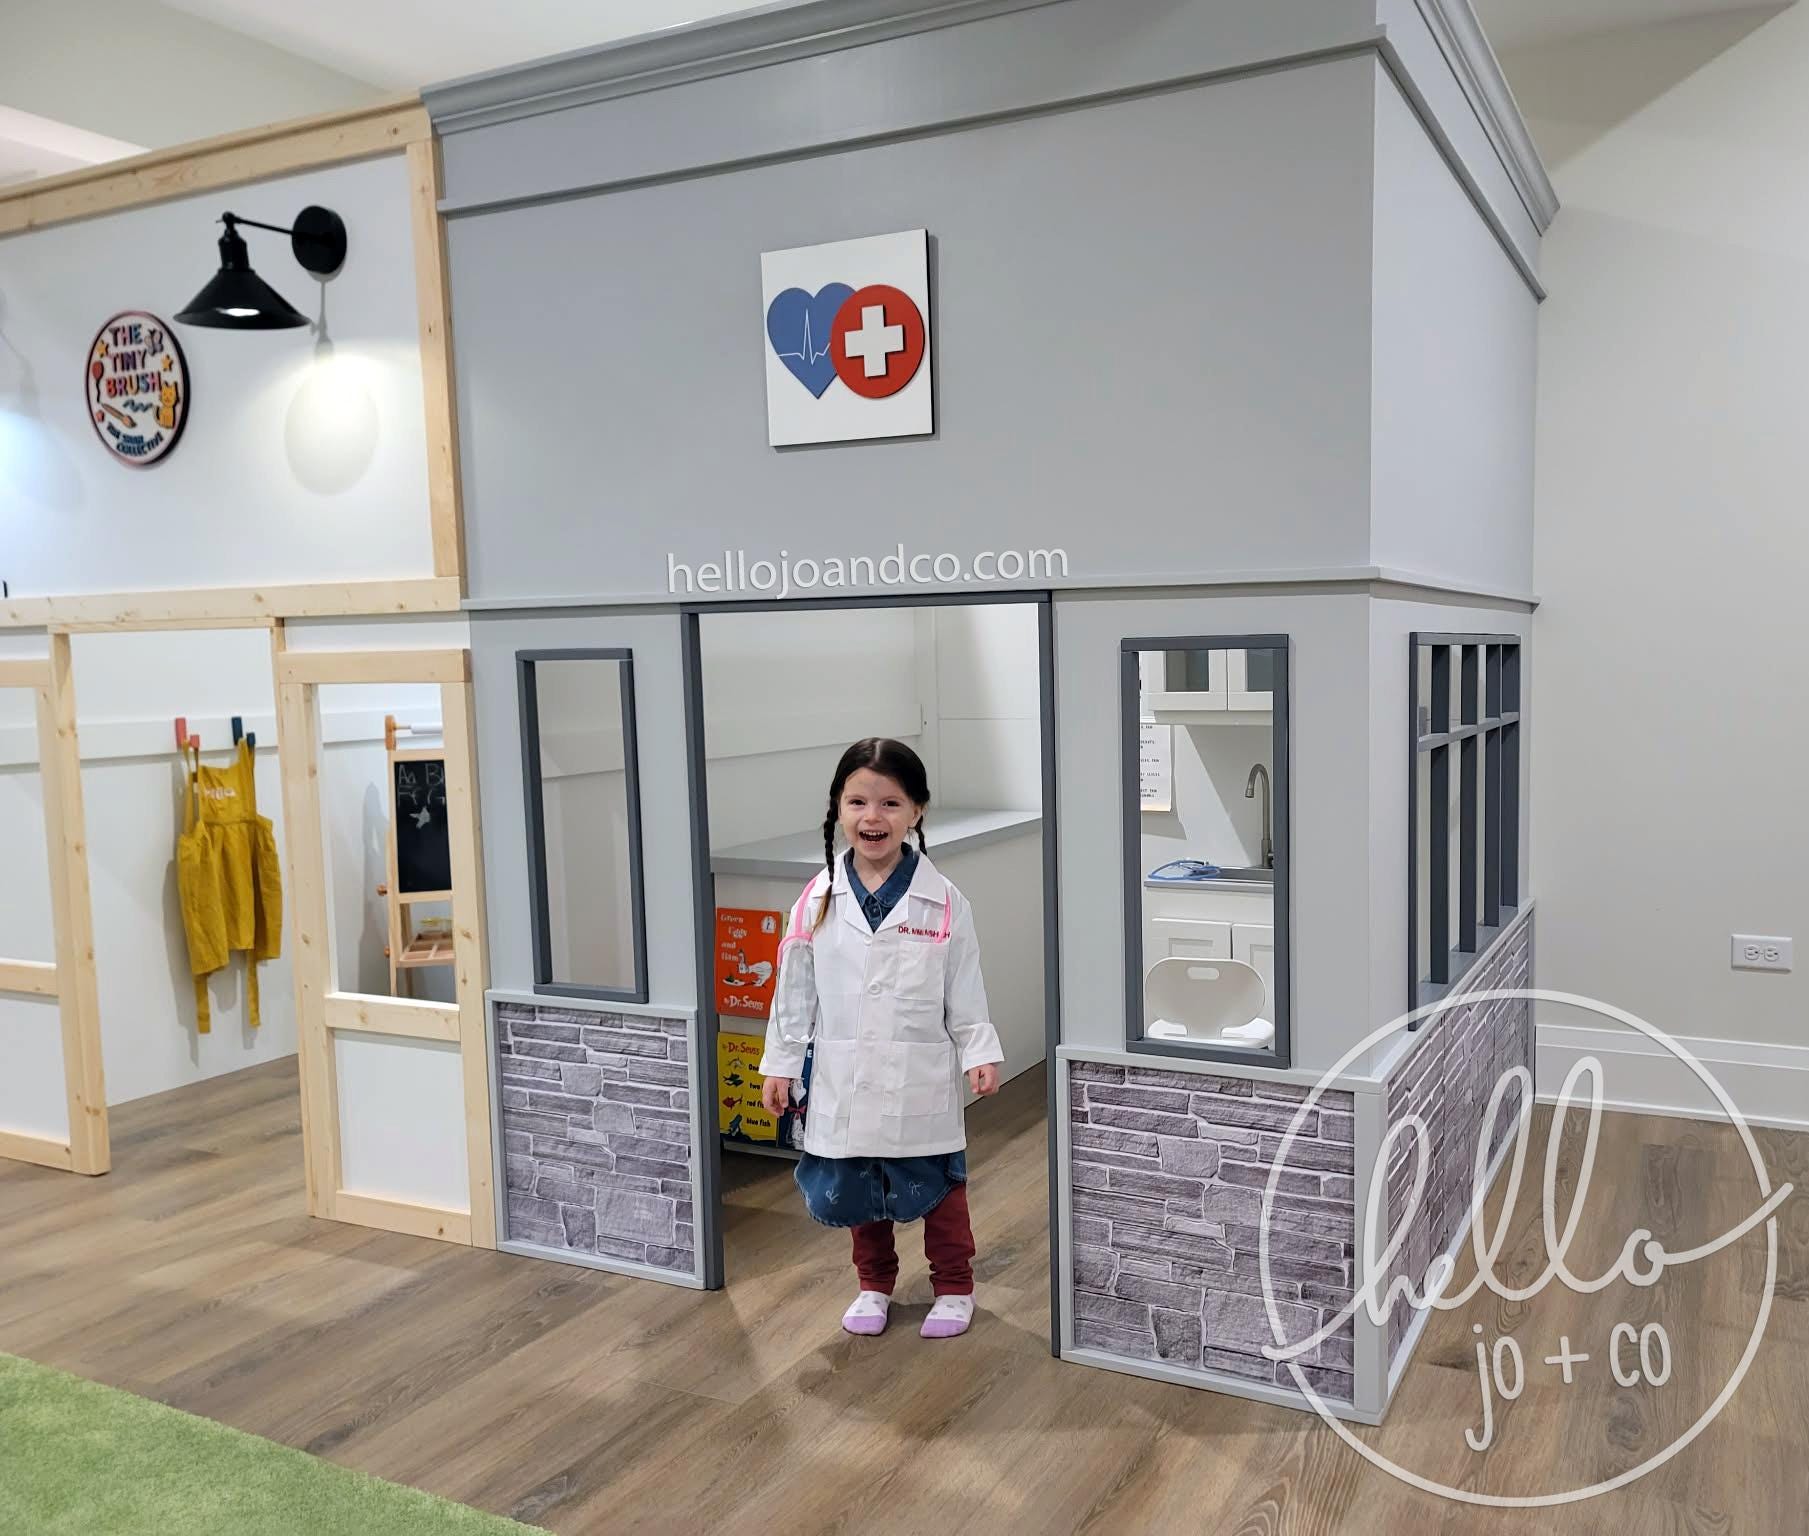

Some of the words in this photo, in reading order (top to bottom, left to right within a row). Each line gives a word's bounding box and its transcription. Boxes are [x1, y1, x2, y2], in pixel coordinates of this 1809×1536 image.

[109, 324, 143, 347] THE
[109, 349, 147, 373] TINY
[106, 371, 162, 398] BRUSH
[898, 925, 911, 935] DR.
[729, 995, 742, 1008] Dr.
[742, 995, 764, 1010] Seuss
[728, 1041, 740, 1053] Dr.
[740, 1041, 760, 1056] Seuss
[746, 1117, 759, 1125] blue
[760, 1118, 771, 1127] fish
